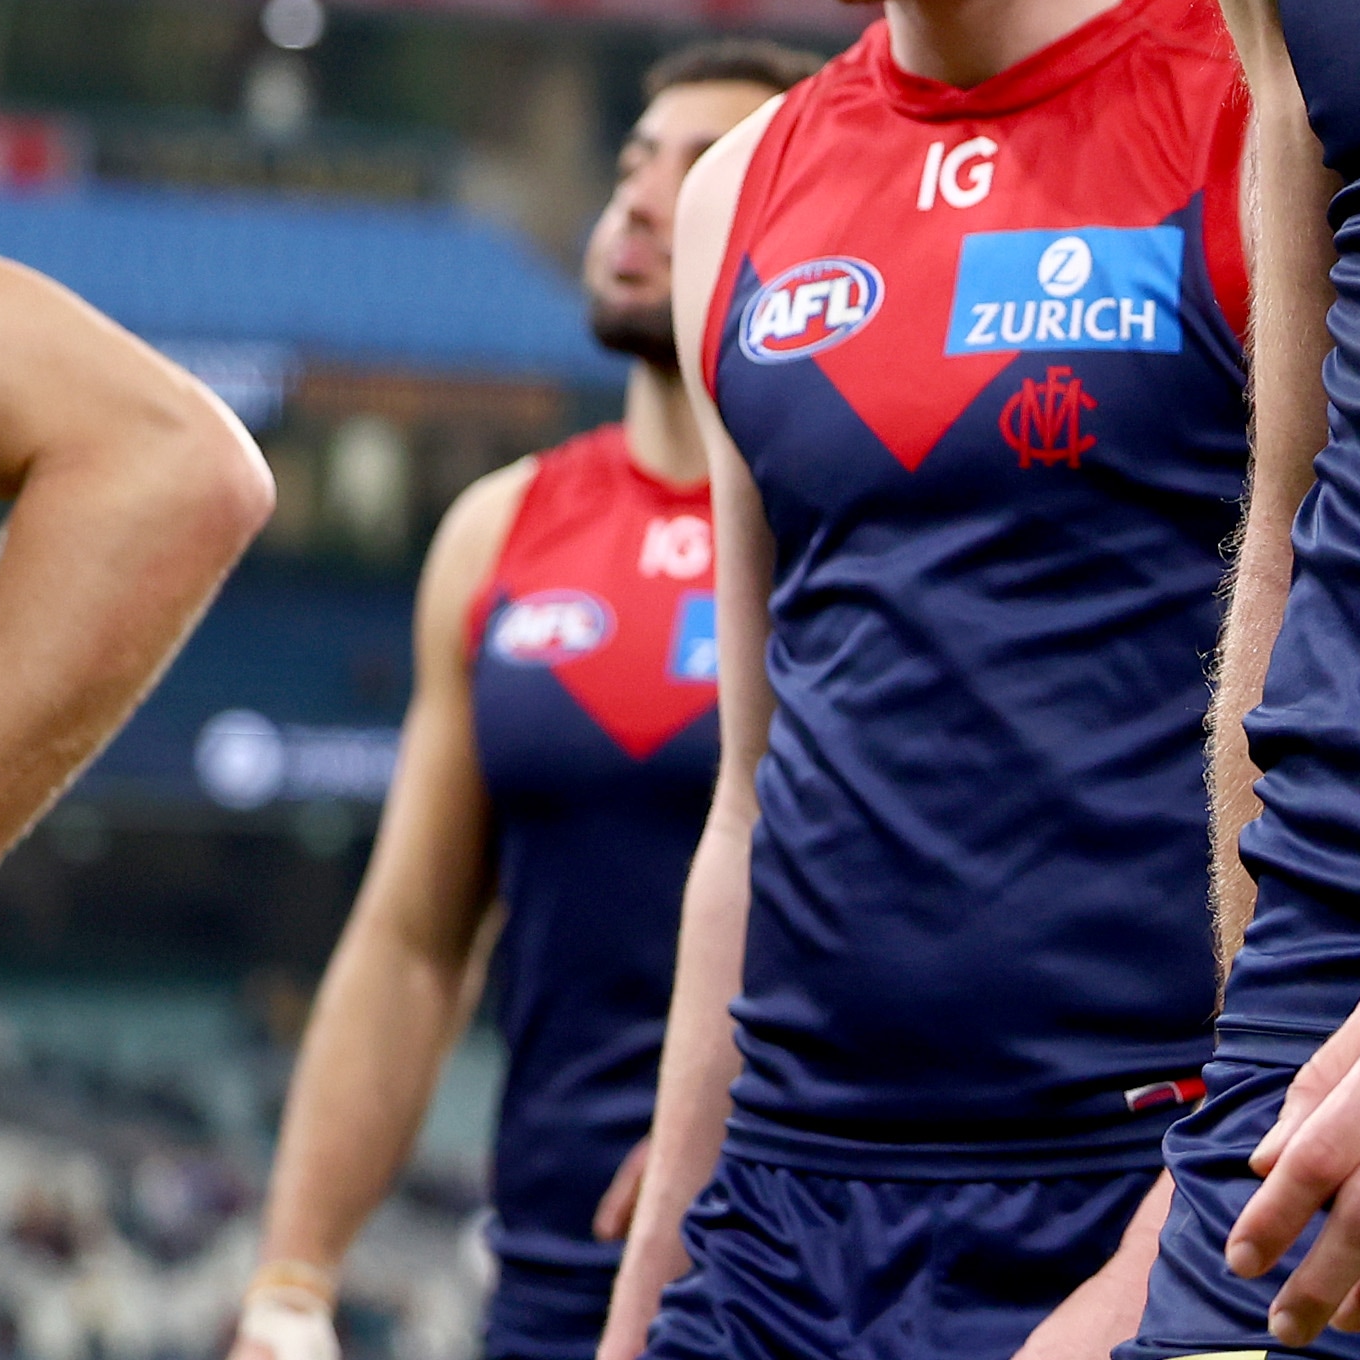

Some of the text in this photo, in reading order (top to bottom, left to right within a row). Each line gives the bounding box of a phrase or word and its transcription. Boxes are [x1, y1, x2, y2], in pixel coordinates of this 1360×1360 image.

[917, 136, 998, 211] IG
[748, 275, 868, 346] AFL
[964, 296, 1157, 346] ZURICH
